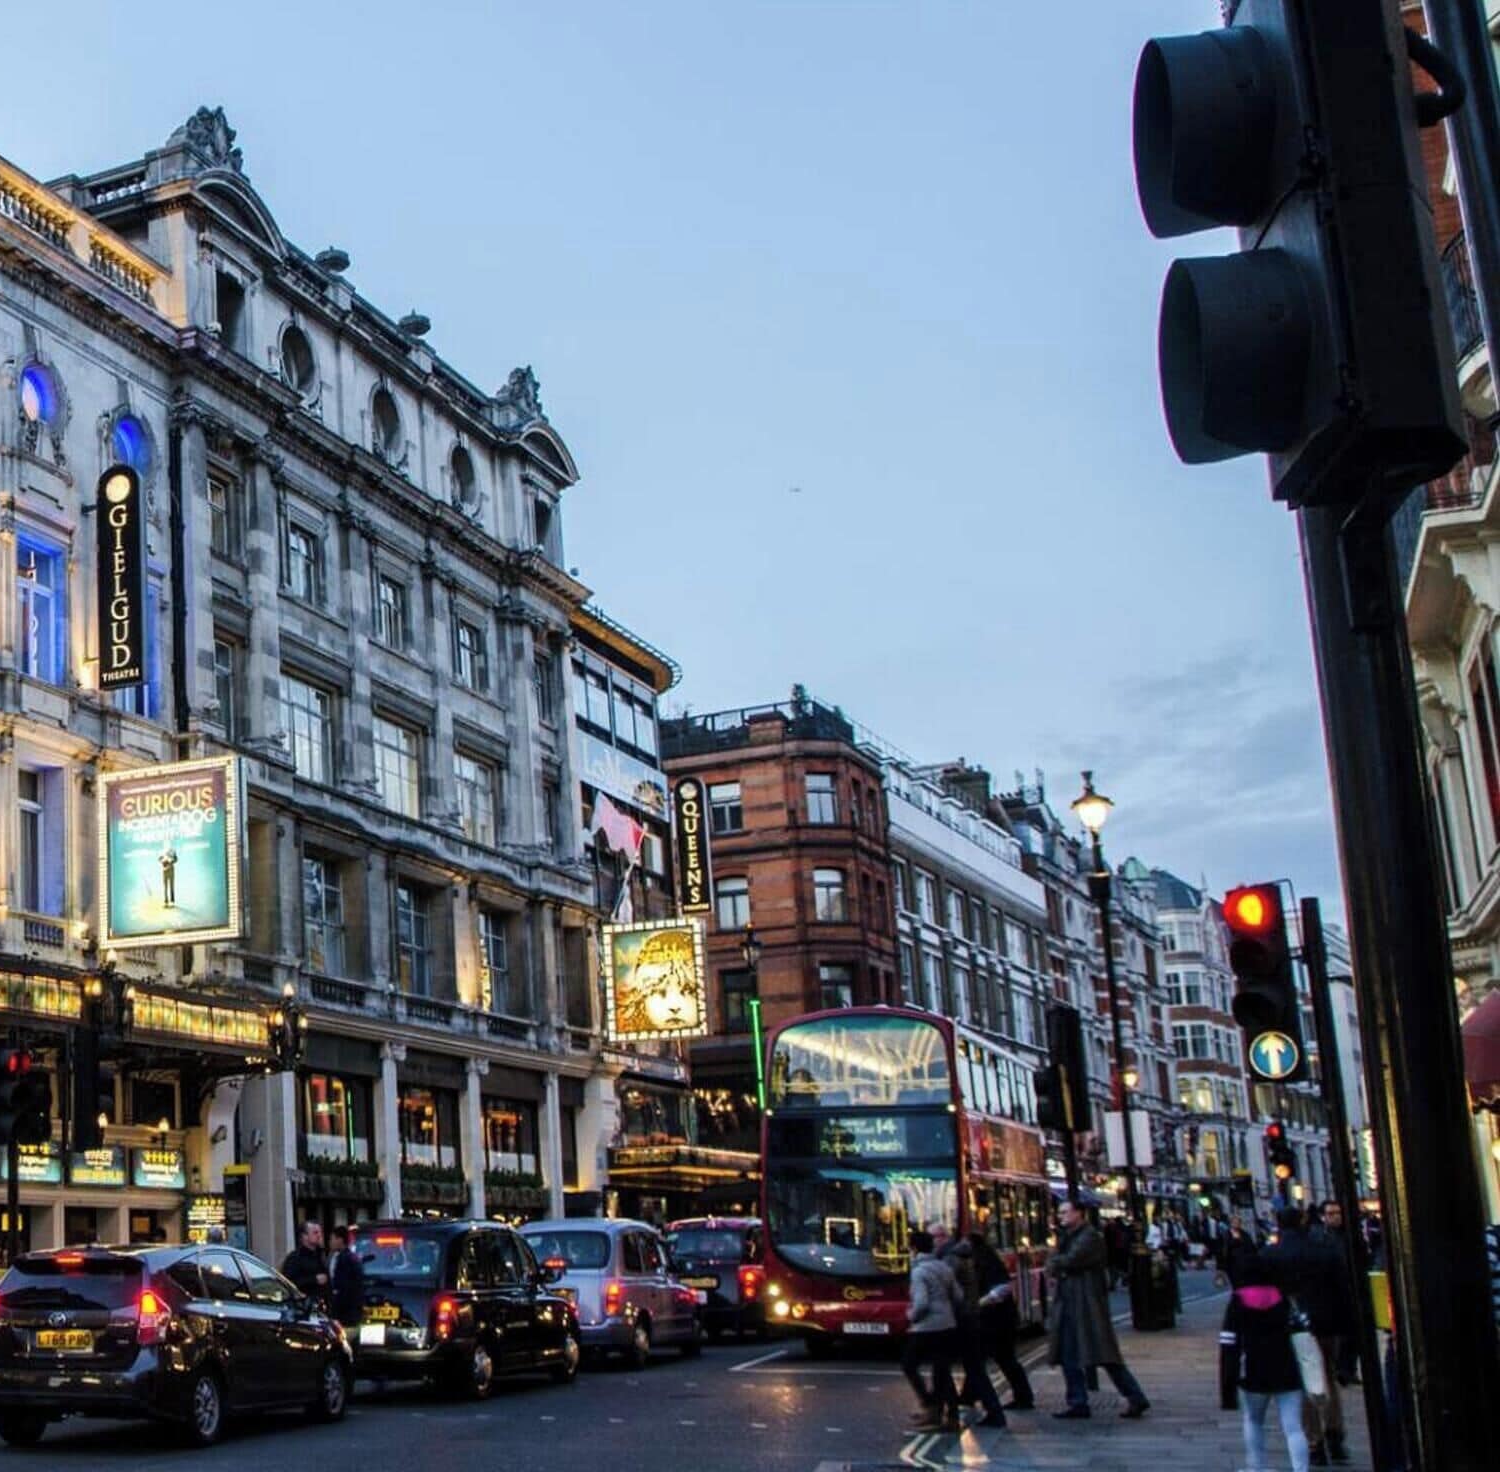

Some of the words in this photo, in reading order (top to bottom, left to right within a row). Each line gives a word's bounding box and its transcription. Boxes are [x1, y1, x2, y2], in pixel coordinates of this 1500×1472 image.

[109, 504, 131, 669] GIELGUD
[102, 668, 139, 682] THEATRE
[120, 787, 214, 818] CURIOUS
[179, 807, 217, 826] DOG
[682, 801, 702, 904] QUEENS
[876, 1118, 896, 1135] 14
